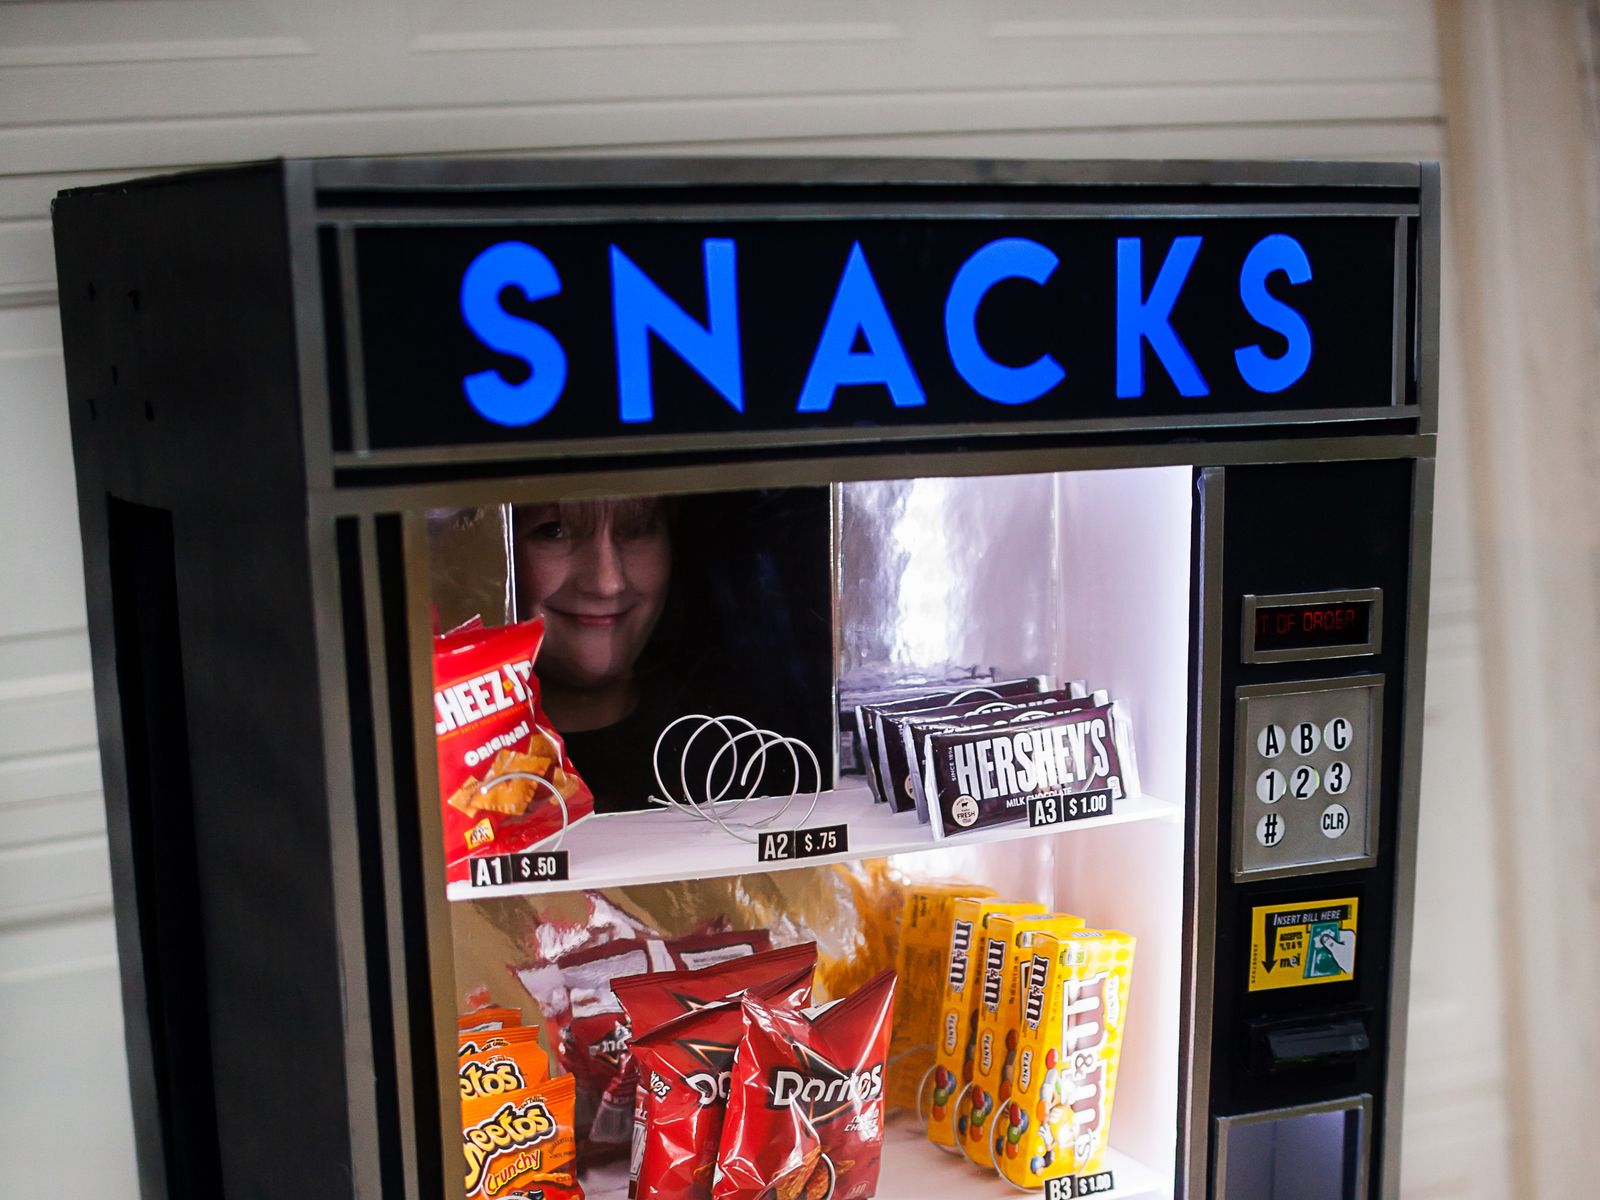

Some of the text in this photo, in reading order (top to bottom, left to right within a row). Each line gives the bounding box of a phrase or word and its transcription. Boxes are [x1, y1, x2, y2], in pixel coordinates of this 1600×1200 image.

[461, 233, 1313, 427] SNACKS
[1265, 718, 1346, 756] A B C
[953, 718, 1110, 801] HERSHEY'S
[1265, 762, 1343, 800] 1 2 3
[1006, 796, 1026, 808] MILK
[1034, 799, 1057, 825] A3
[1323, 813, 1345, 831] CLR
[763, 834, 788, 860] A2
[476, 857, 503, 886] A1
[1273, 913, 1301, 926] INSERT
[1302, 912, 1319, 923] BILL
[1321, 909, 1342, 920] HERE
[773, 1064, 883, 1106] Doritos
[485, 1149, 541, 1195] Crunchy
